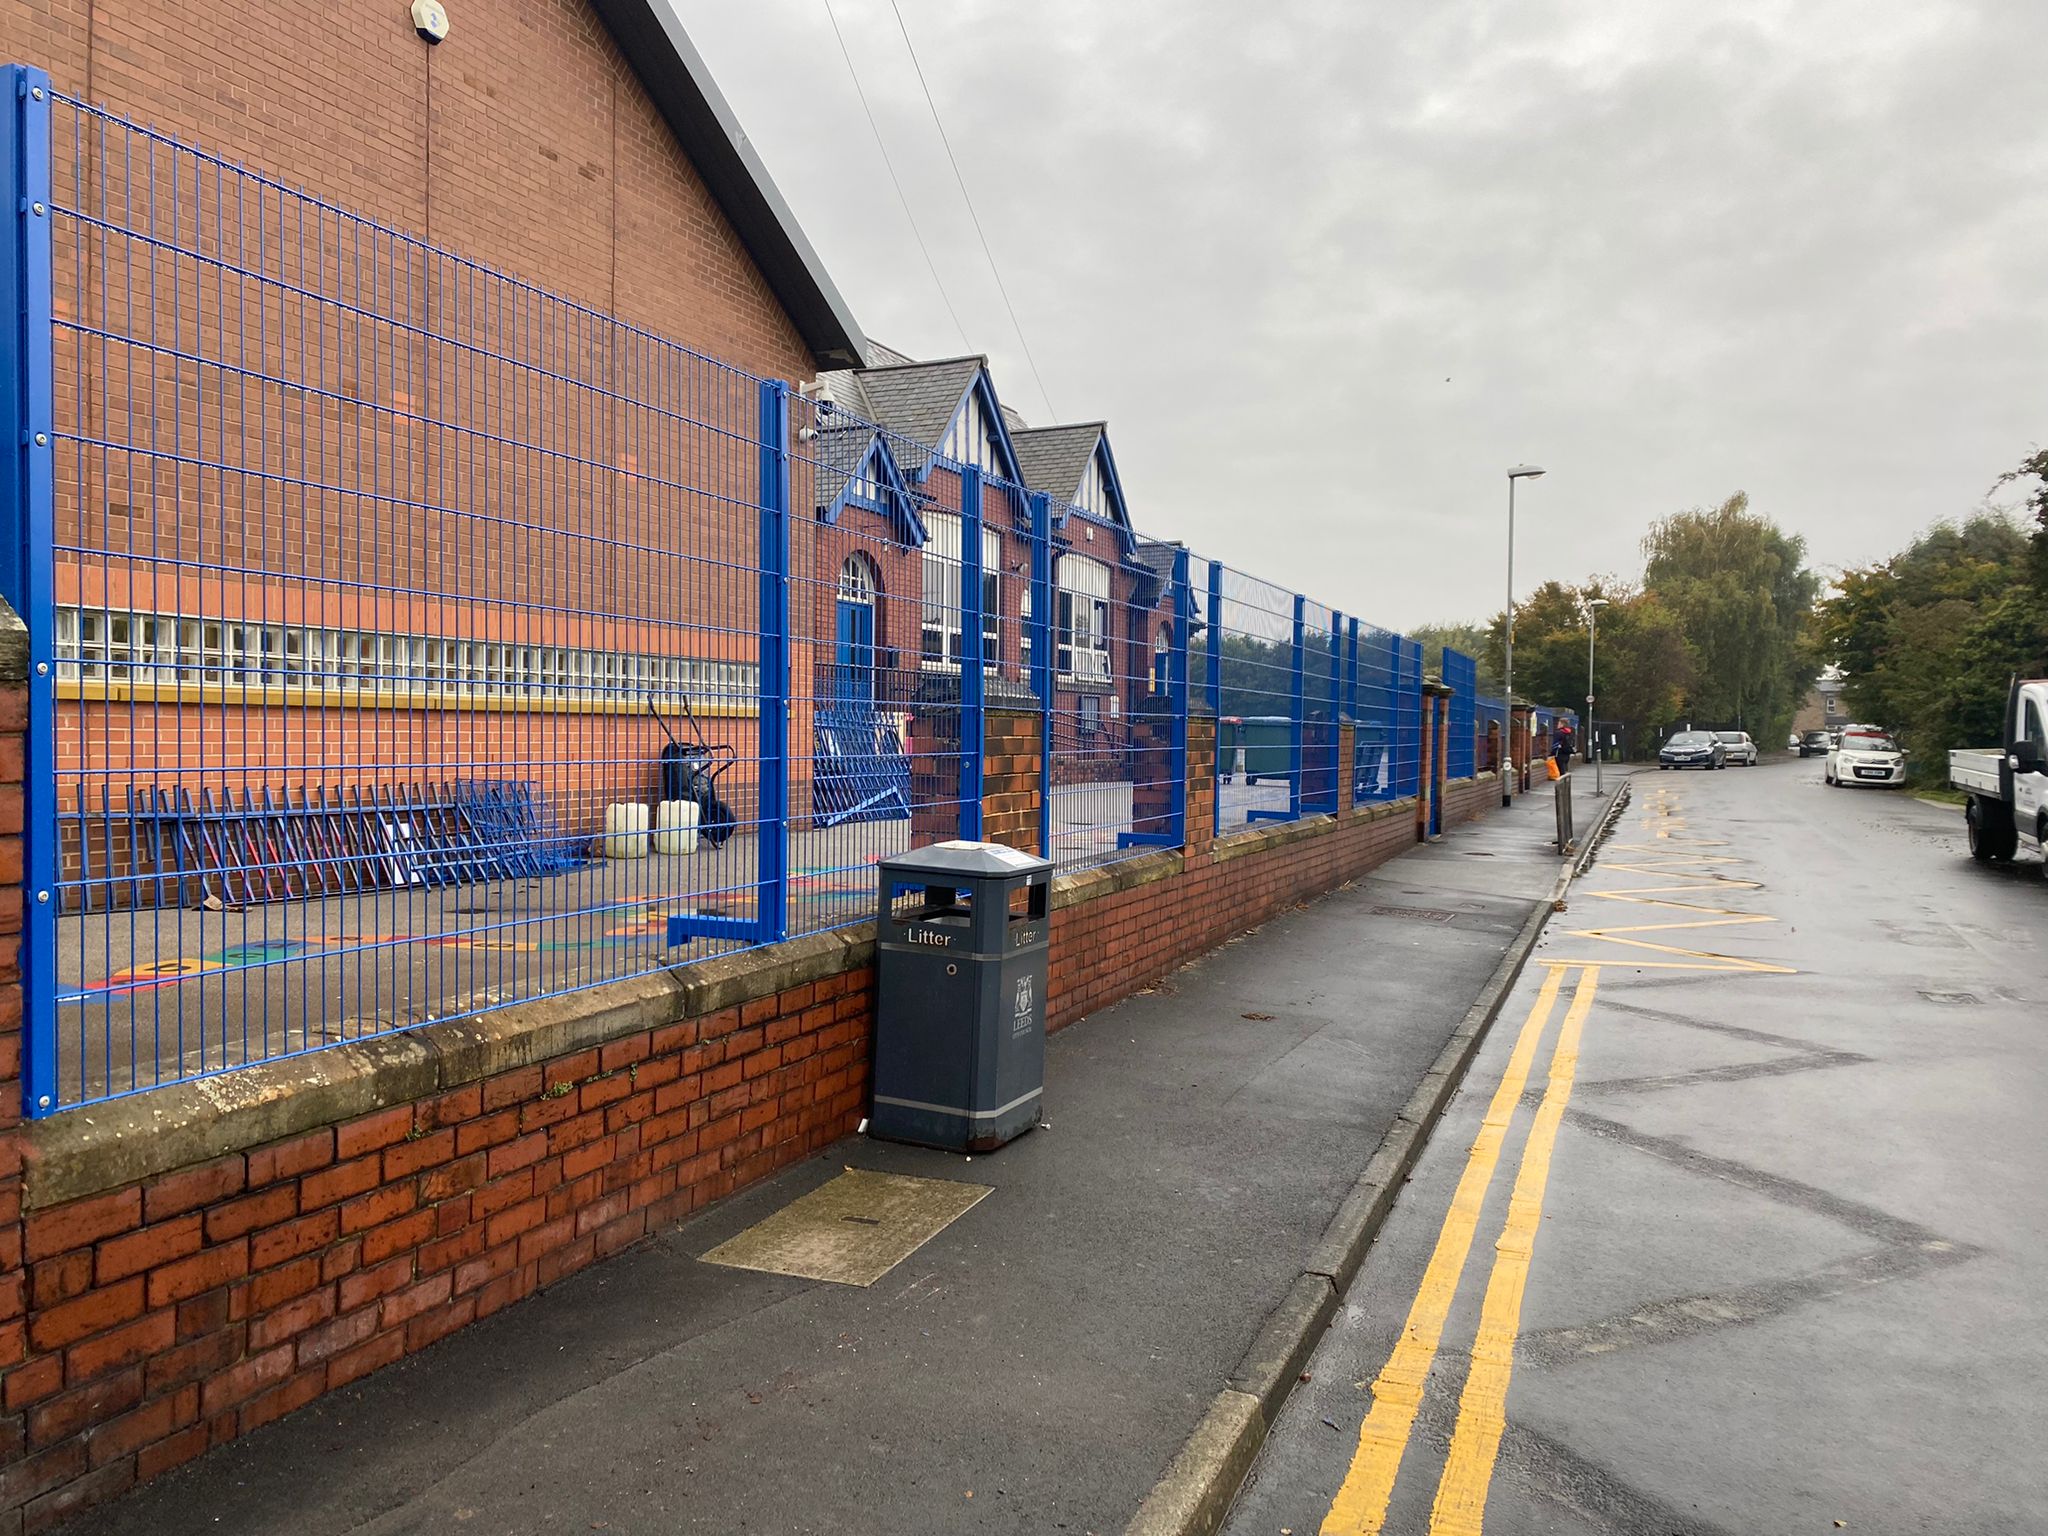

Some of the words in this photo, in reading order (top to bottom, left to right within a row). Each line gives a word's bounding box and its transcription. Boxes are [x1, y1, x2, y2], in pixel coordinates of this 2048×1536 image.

[908, 927, 951, 946] Litter
[1015, 930, 1036, 947] Litter
[1013, 1014, 1032, 1032] LEEDS
